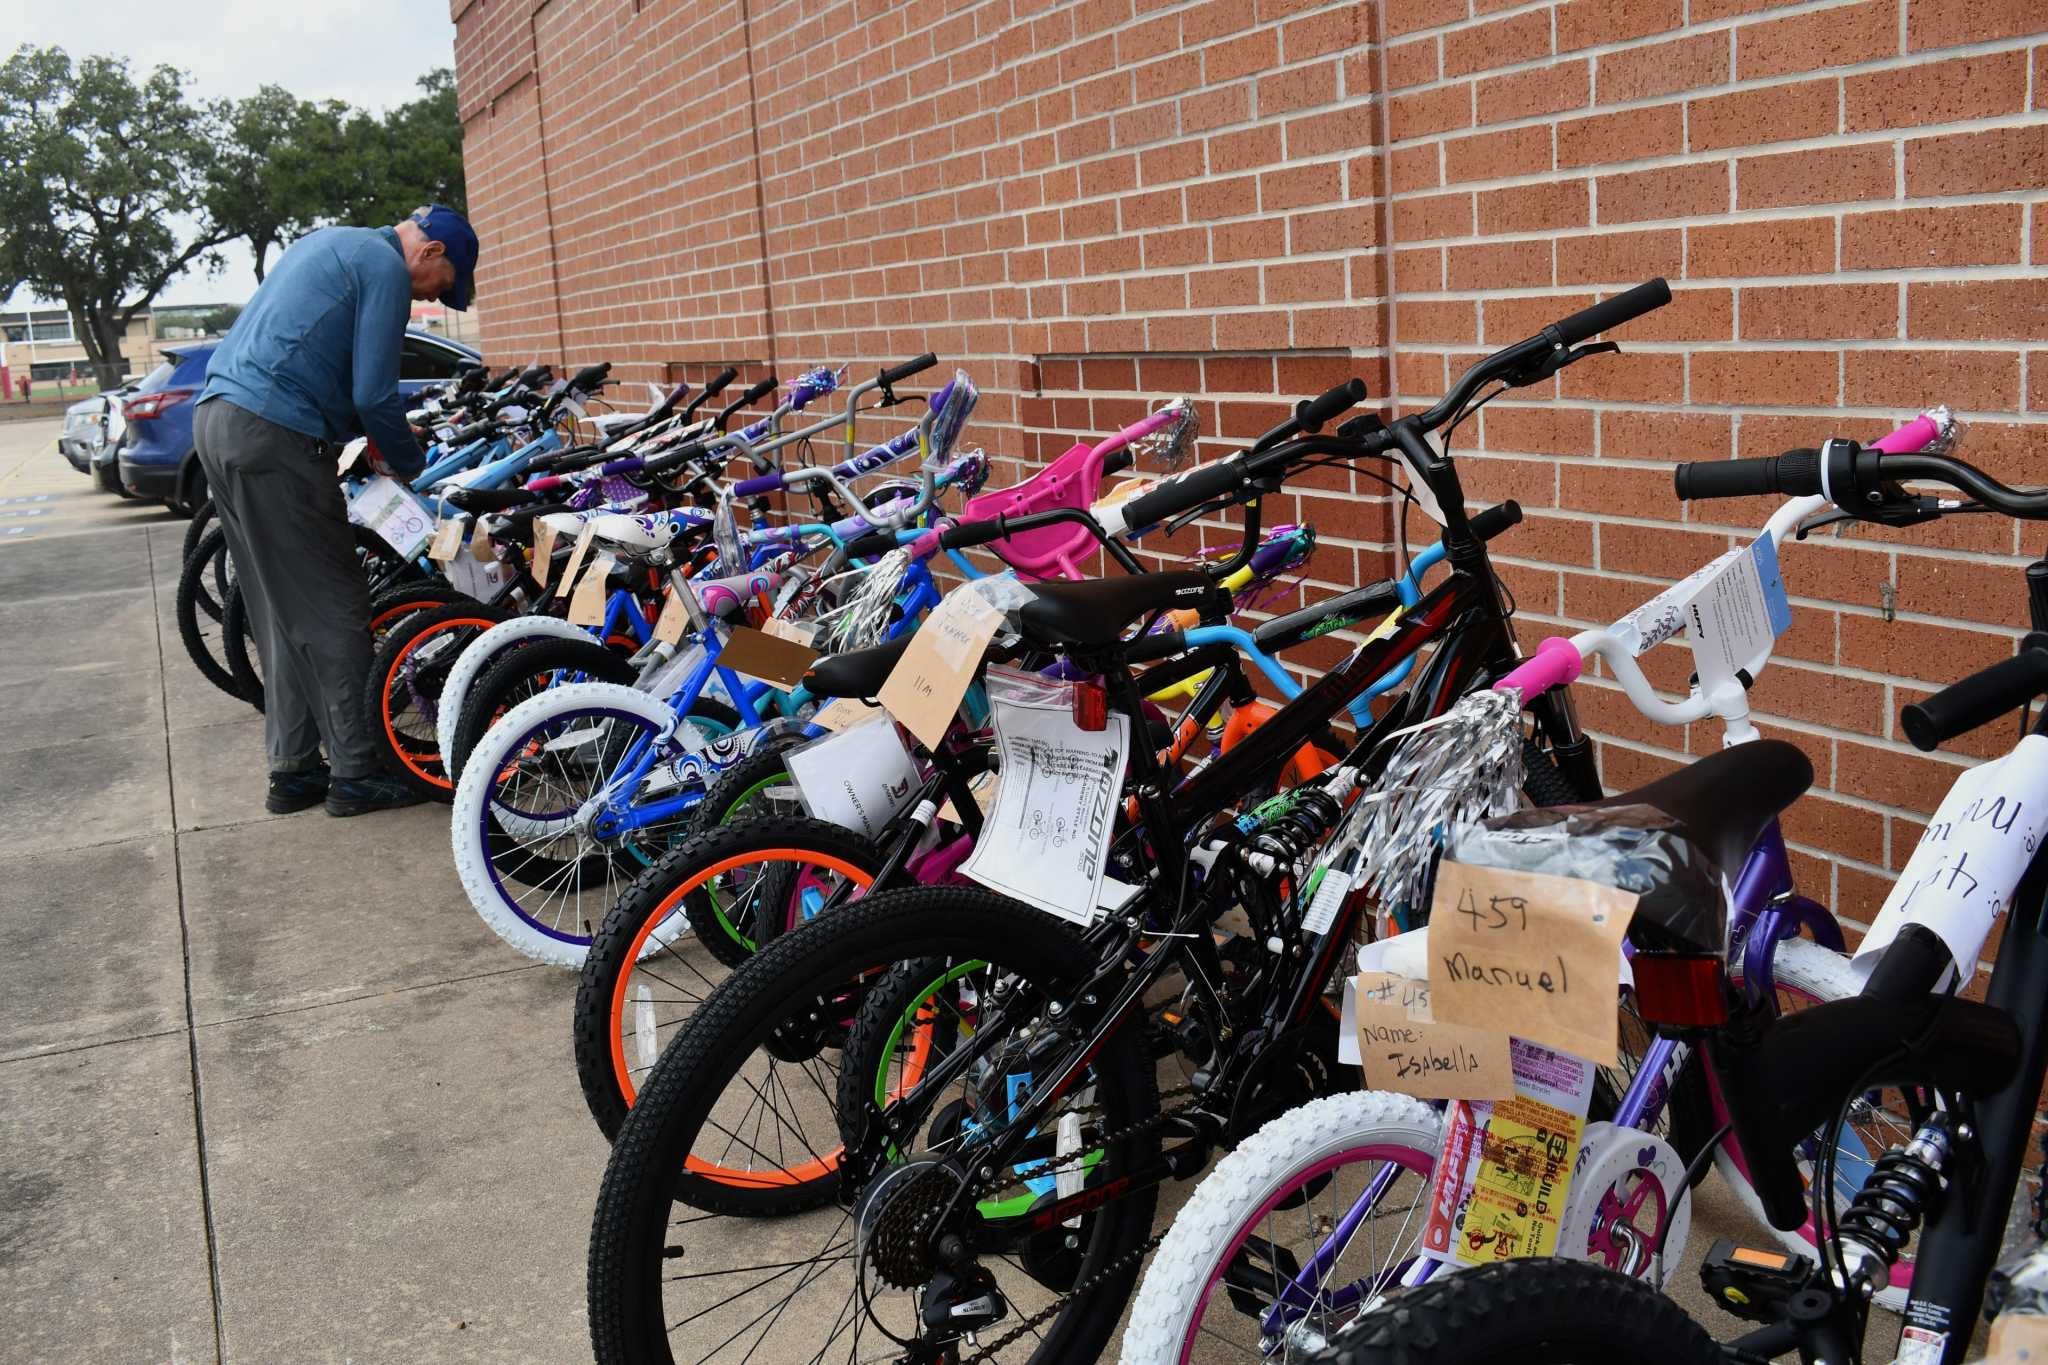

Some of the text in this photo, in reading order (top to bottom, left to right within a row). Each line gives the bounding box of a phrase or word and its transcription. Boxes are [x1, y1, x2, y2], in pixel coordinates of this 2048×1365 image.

[1692, 604, 1704, 639] HUFFY
[1457, 887, 1529, 932] 459
[1443, 952, 1567, 993] Manuel
[1363, 1024, 1424, 1046] Name:
[1536, 1161, 1558, 1214] BUILD
